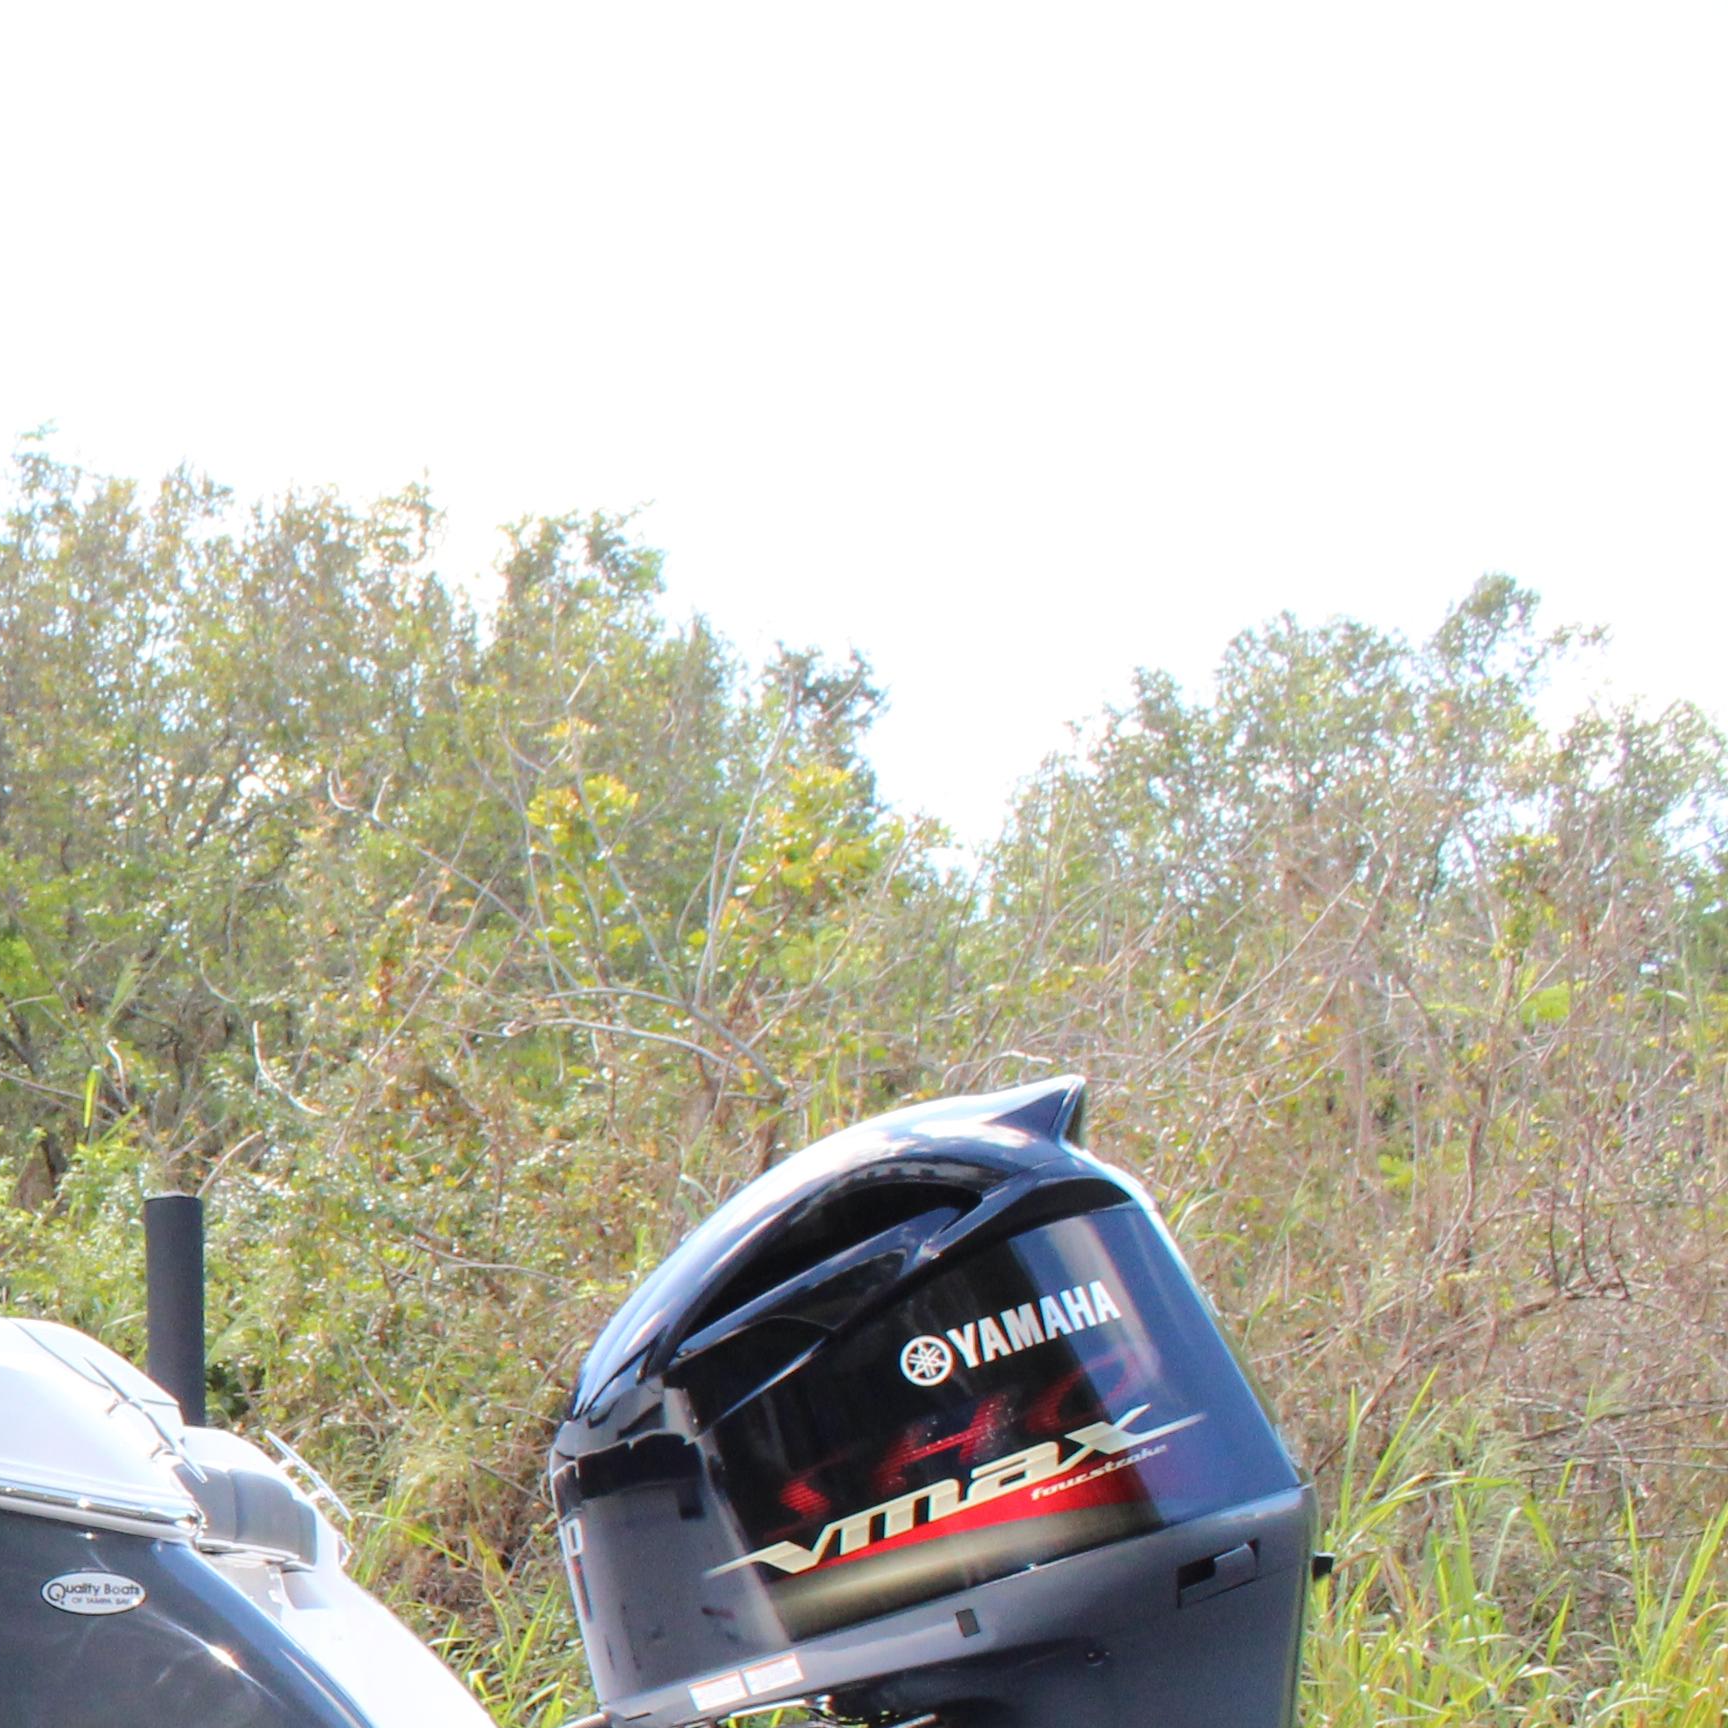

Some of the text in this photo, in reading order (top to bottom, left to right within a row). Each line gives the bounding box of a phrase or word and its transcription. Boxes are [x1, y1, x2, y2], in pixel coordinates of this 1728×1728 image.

[946, 1280, 1122, 1369] YAMAHA
[47, 1583, 140, 1605] Quality Boats
